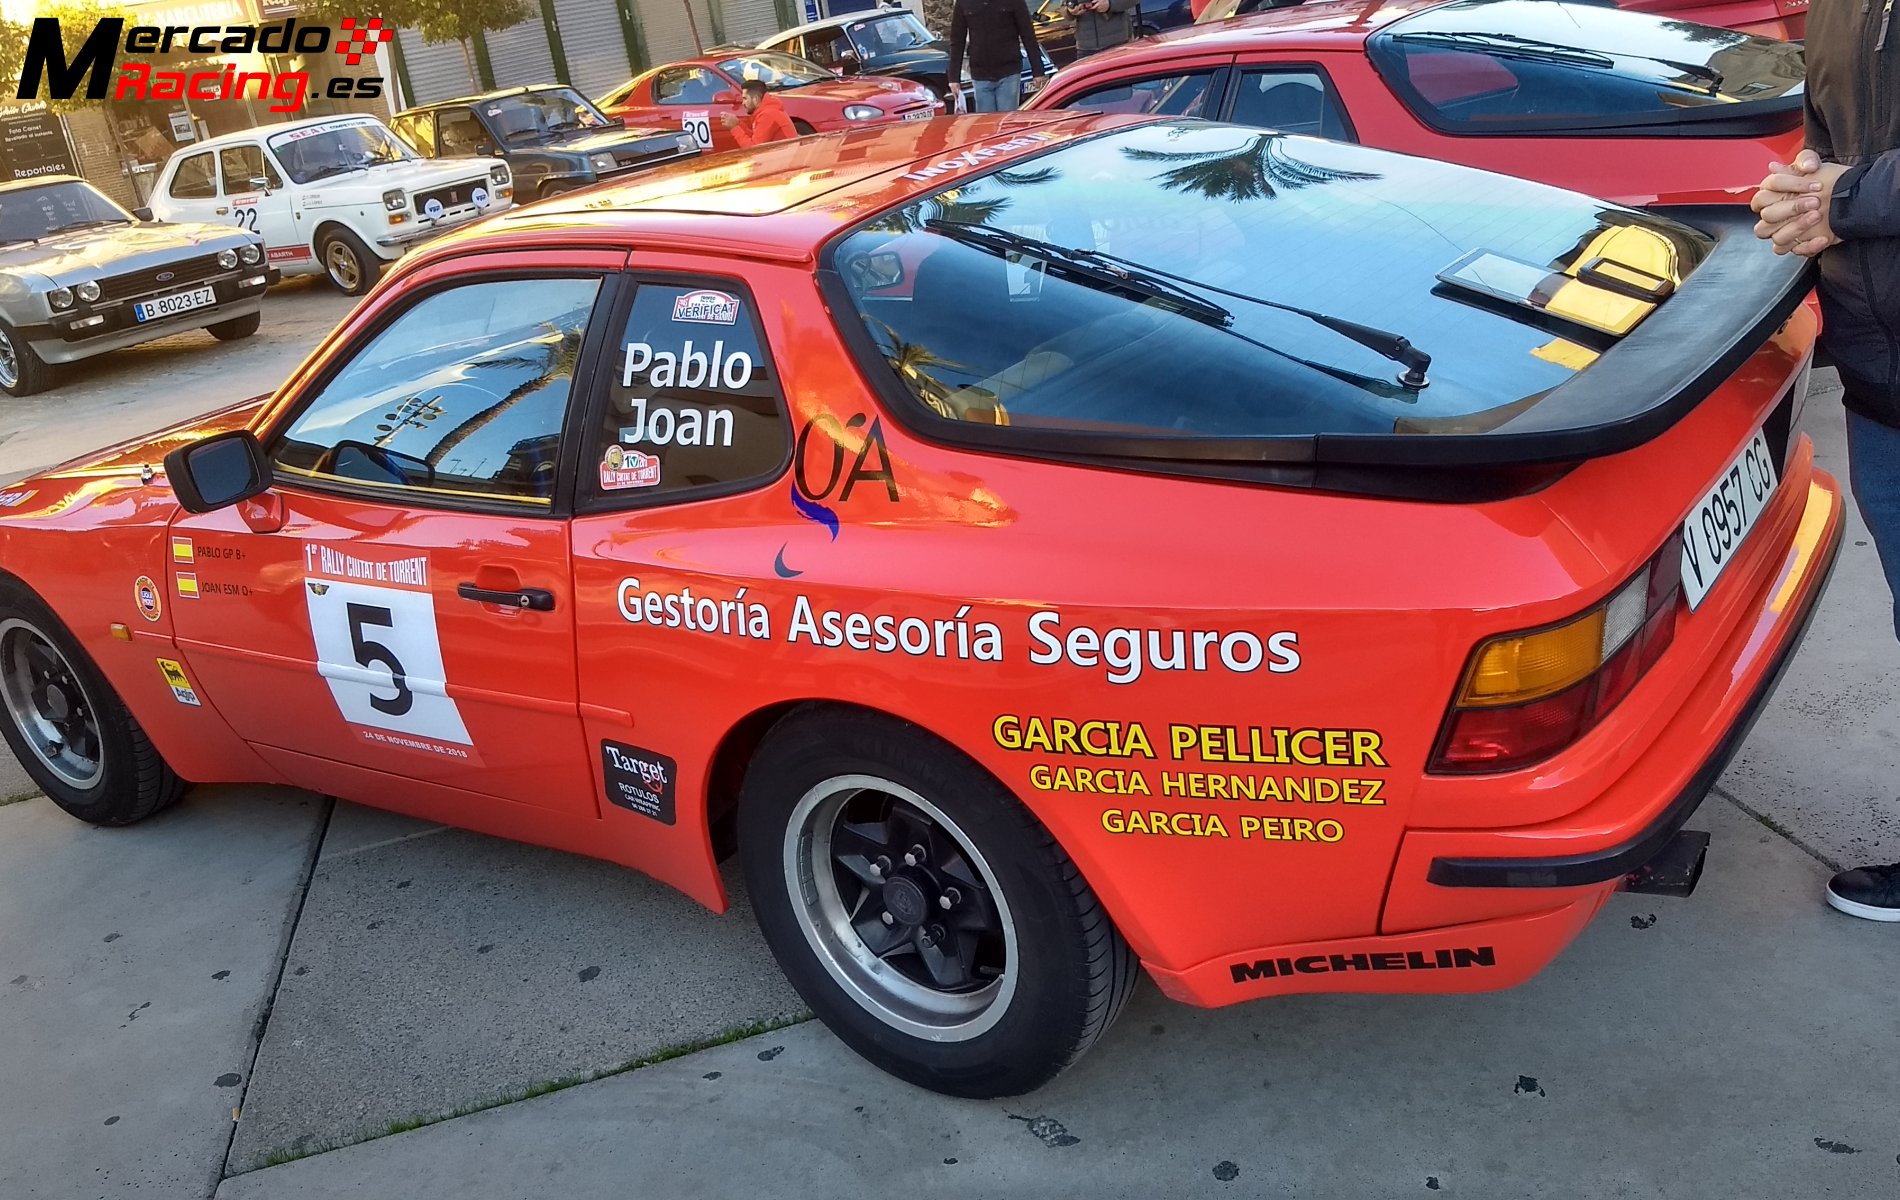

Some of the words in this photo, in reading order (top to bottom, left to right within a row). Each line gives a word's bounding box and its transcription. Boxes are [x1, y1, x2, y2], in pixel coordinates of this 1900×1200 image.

[14, 163, 66, 178] Reportajes
[235, 208, 260, 234] 22
[145, 303, 156, 317] B
[678, 303, 735, 318] VERIFICAT
[622, 340, 752, 389] Pablo
[624, 398, 734, 446] Joan
[1683, 525, 1703, 588] V
[1702, 465, 1747, 564] 0957
[1745, 437, 1770, 502] CG
[198, 546, 221, 559] PABLO
[223, 548, 233, 559] GP
[321, 545, 344, 577] RALLY
[346, 555, 374, 580] CIUTAT
[376, 562, 387, 581] DE
[388, 557, 427, 587] TORRENT
[202, 581, 222, 594] JOAN
[617, 576, 771, 640] Gestoría
[787, 595, 1004, 662] Asesoría
[1027, 610, 1301, 685] Seguros
[346, 602, 413, 716] 5
[363, 731, 374, 740] 24
[374, 732, 386, 743] DE
[387, 735, 433, 752] NOVEMBRE
[434, 744, 447, 755] DE
[993, 715, 1157, 759] GARCIA
[1170, 723, 1390, 767] PELLICER
[605, 745, 668, 784] Target
[618, 781, 660, 804] ROTULOS
[1030, 765, 1152, 796] GARCIA
[1161, 771, 1387, 806] HERNANDEZ
[1102, 809, 1229, 839] GARCIA
[1240, 815, 1344, 844] PEIRO
[1230, 946, 1496, 984] MICHELIN
